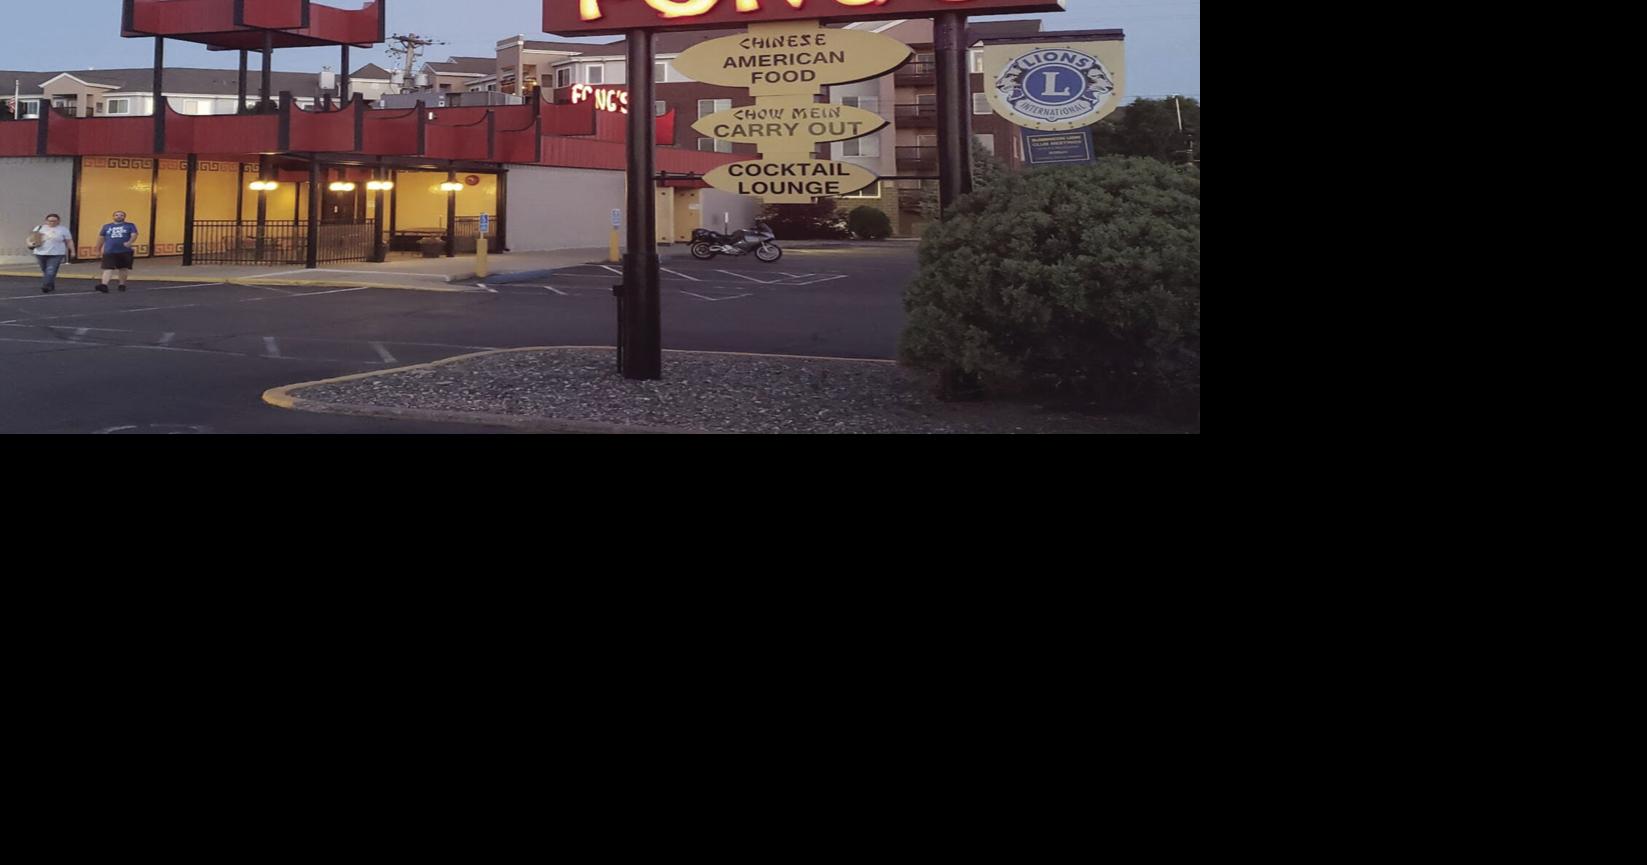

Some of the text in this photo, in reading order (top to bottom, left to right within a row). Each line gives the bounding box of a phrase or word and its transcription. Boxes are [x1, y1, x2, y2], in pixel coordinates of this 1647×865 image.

[739, 33, 826, 49] CHINESE
[723, 50, 845, 69] AMERICAN
[1022, 52, 1089, 67] LIONS
[751, 69, 816, 84] FOOD
[1041, 71, 1070, 96] L
[733, 107, 841, 120] CHOW MEIN
[1020, 102, 1086, 116] INTERNATIONAL
[713, 121, 863, 138] CARRY OUT
[728, 162, 850, 177] COCKTAIL
[738, 181, 840, 195] LOUNGE
